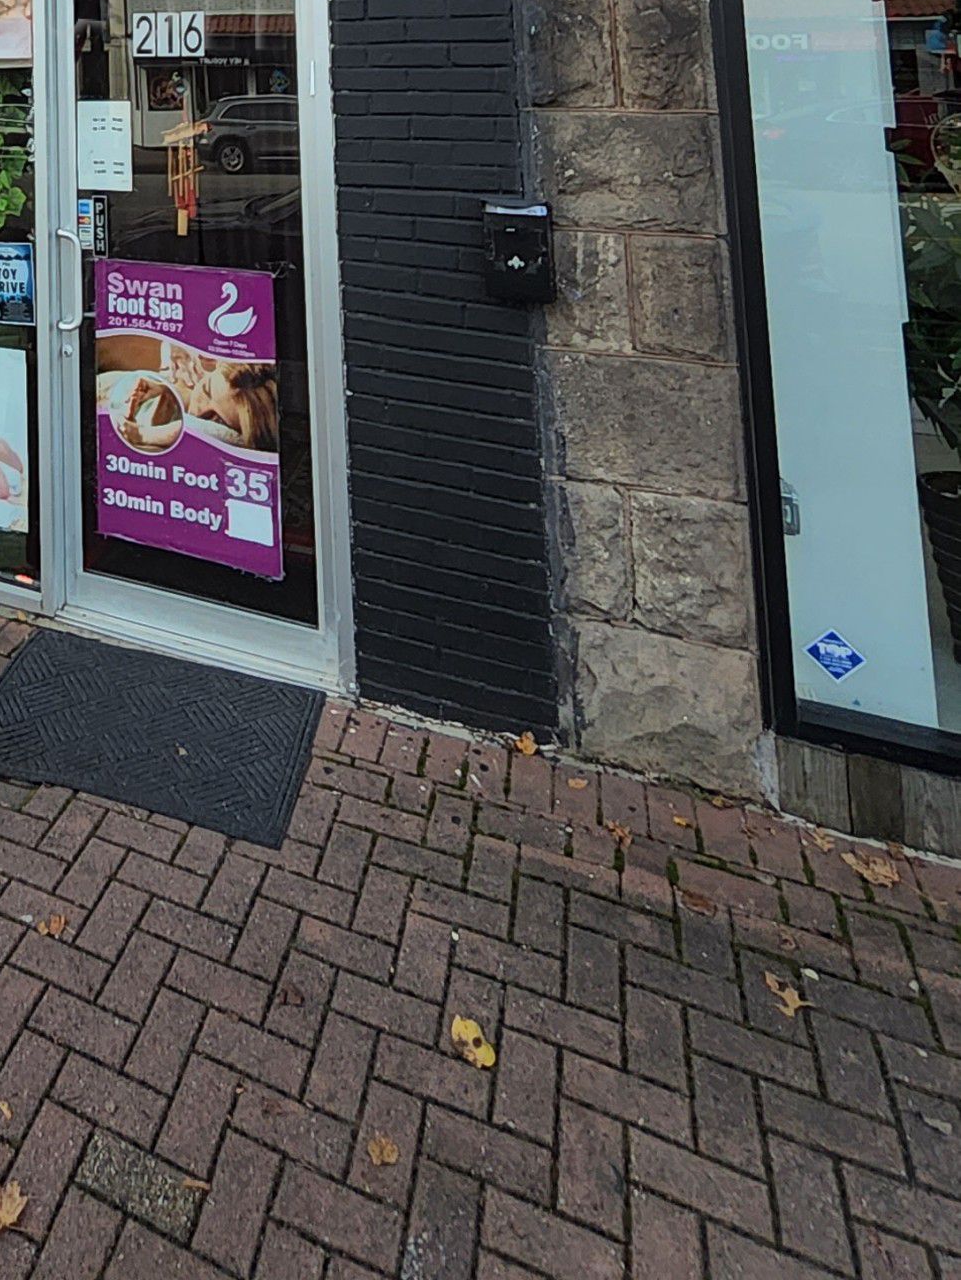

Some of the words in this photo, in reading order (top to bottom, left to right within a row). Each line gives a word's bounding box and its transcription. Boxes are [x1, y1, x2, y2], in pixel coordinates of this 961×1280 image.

[135, 13, 203, 55] 216
[94, 202, 106, 252] PUSH
[107, 271, 183, 300] Swan
[107, 293, 146, 317] Foot
[148, 297, 183, 321] Spa
[108, 316, 183, 333] 201.564.7897
[105, 454, 167, 481] 30min
[172, 465, 219, 492] Foot
[226, 468, 270, 502] 35
[103, 487, 164, 516] 30min
[170, 500, 223, 531] Body
